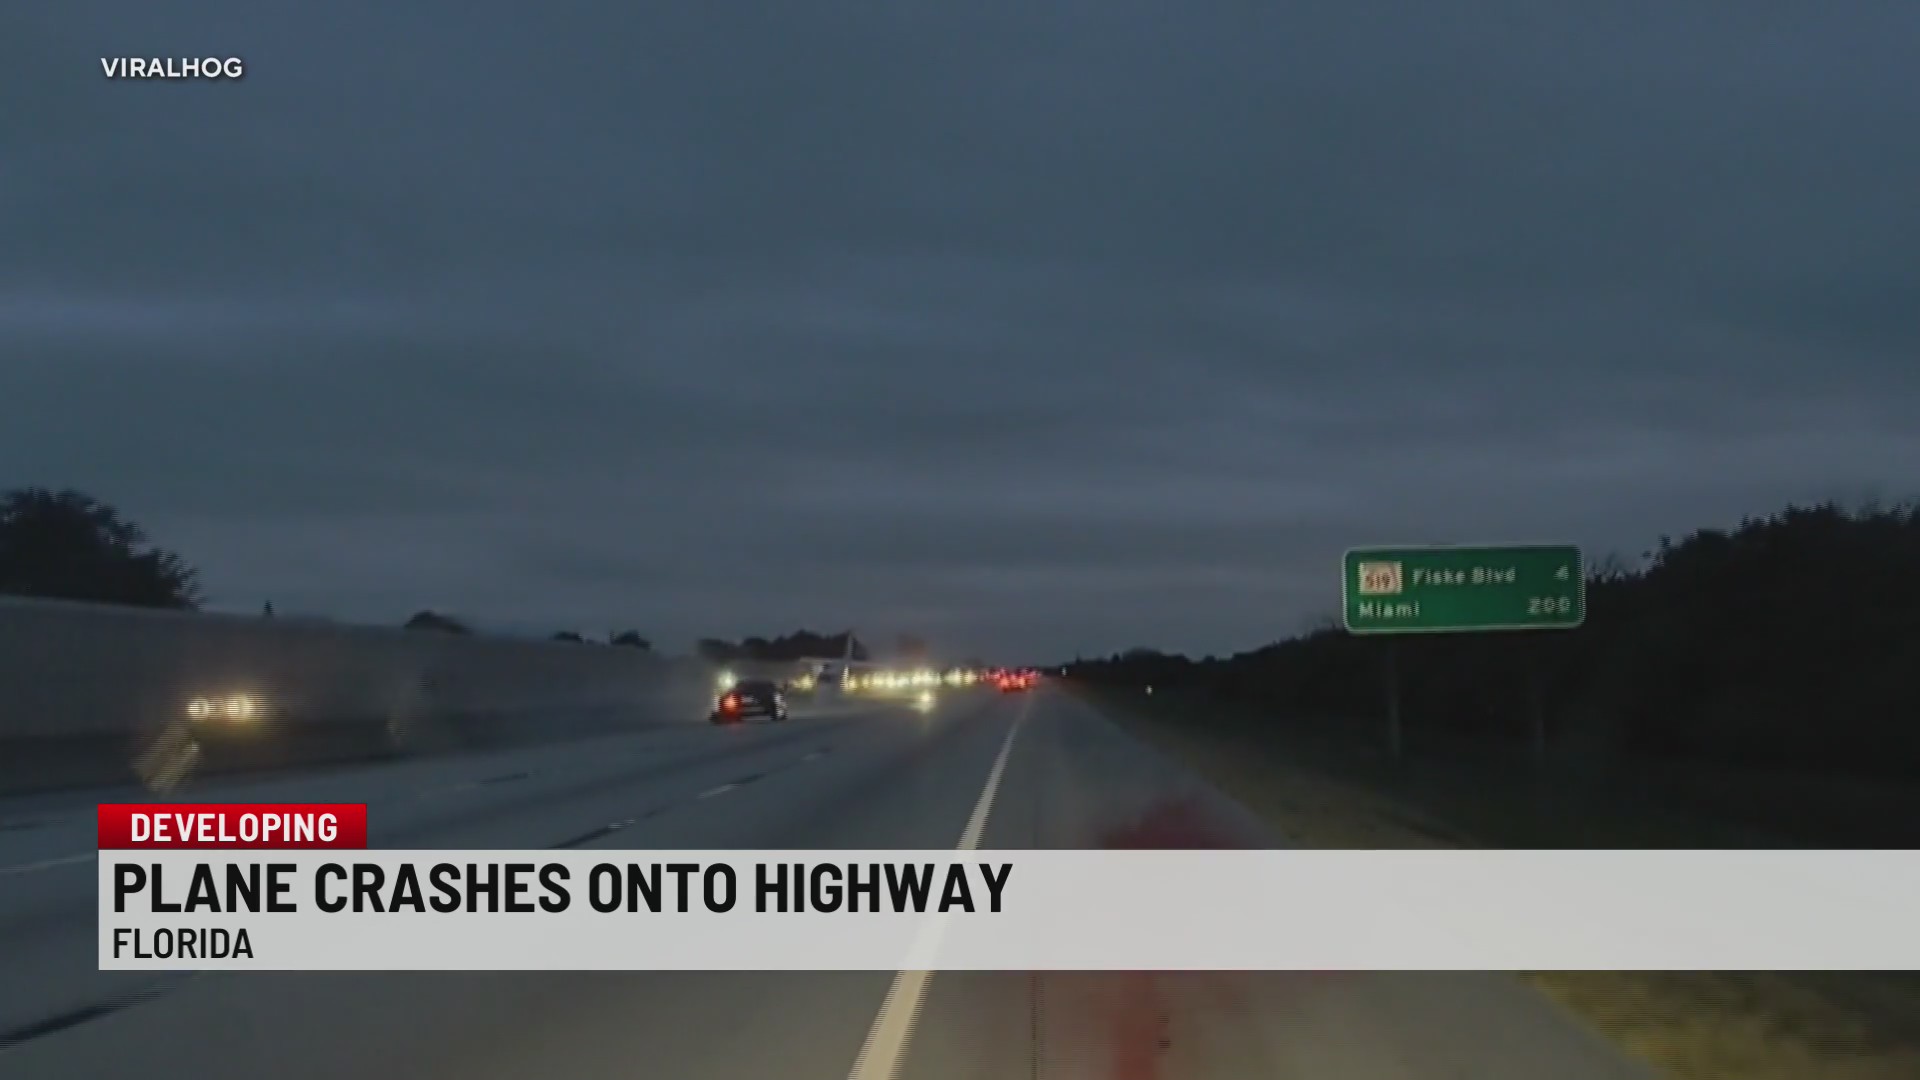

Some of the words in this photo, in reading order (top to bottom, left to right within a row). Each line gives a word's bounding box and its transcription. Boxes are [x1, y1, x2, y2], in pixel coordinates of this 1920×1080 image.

[1412, 568, 1465, 585] Fiske
[1471, 566, 1516, 584] Blvd
[1359, 601, 1420, 618] Miami
[1527, 597, 1571, 614] 200
